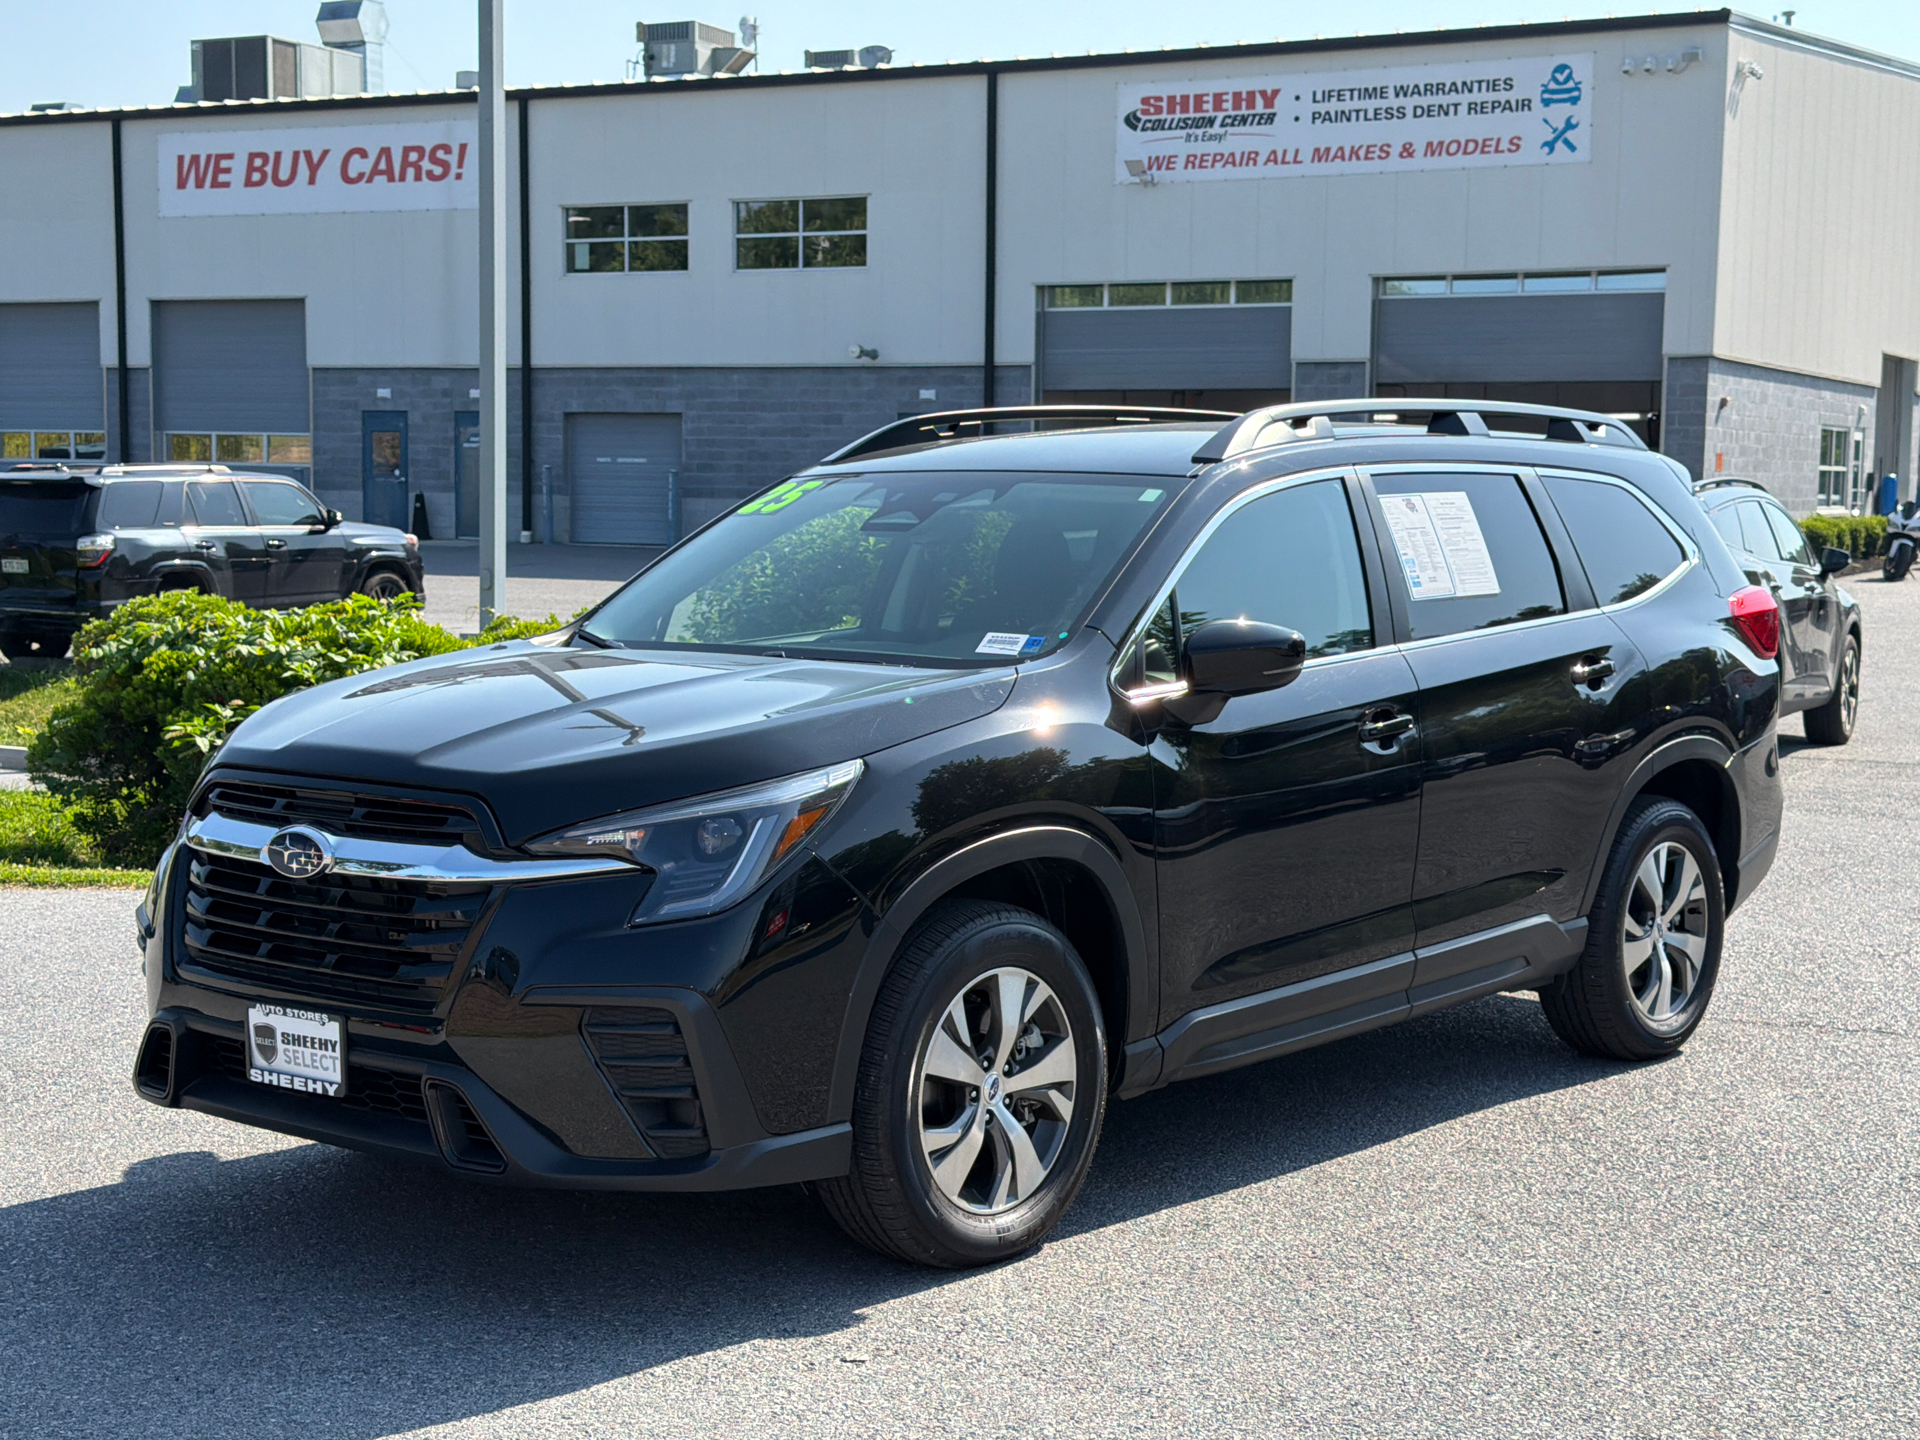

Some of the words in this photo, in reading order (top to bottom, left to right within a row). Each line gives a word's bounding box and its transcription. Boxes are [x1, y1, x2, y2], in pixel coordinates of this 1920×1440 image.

[1140, 88, 1282, 116] SHEEHY
[1312, 85, 1389, 104] LIFETIME
[1394, 77, 1514, 98] WARRANTIES
[1140, 115, 1218, 132] COLLISION
[1219, 112, 1277, 128] CENTER
[1311, 106, 1407, 125] PAINTLESS
[1412, 102, 1462, 119] DENT
[1466, 98, 1533, 116] REPAIR
[1184, 131, 1199, 143] It's
[1201, 130, 1228, 143] Easy!
[1147, 154, 1178, 171] WE
[1184, 150, 1260, 170] REPAIR
[1263, 147, 1304, 167] ALL
[1310, 142, 1392, 164] MAKES
[1398, 141, 1416, 159] &
[1423, 135, 1523, 158] MODELS
[176, 152, 235, 190] WE
[244, 149, 331, 188] BUY
[339, 143, 468, 185] CARS!
[255, 1003, 284, 1015] AUTO
[285, 1008, 330, 1023] STORES
[255, 1036, 276, 1047] SELECT
[280, 1031, 338, 1053] SHEEHY
[283, 1048, 339, 1073] SELECT
[250, 1068, 339, 1097] SHEEHY
